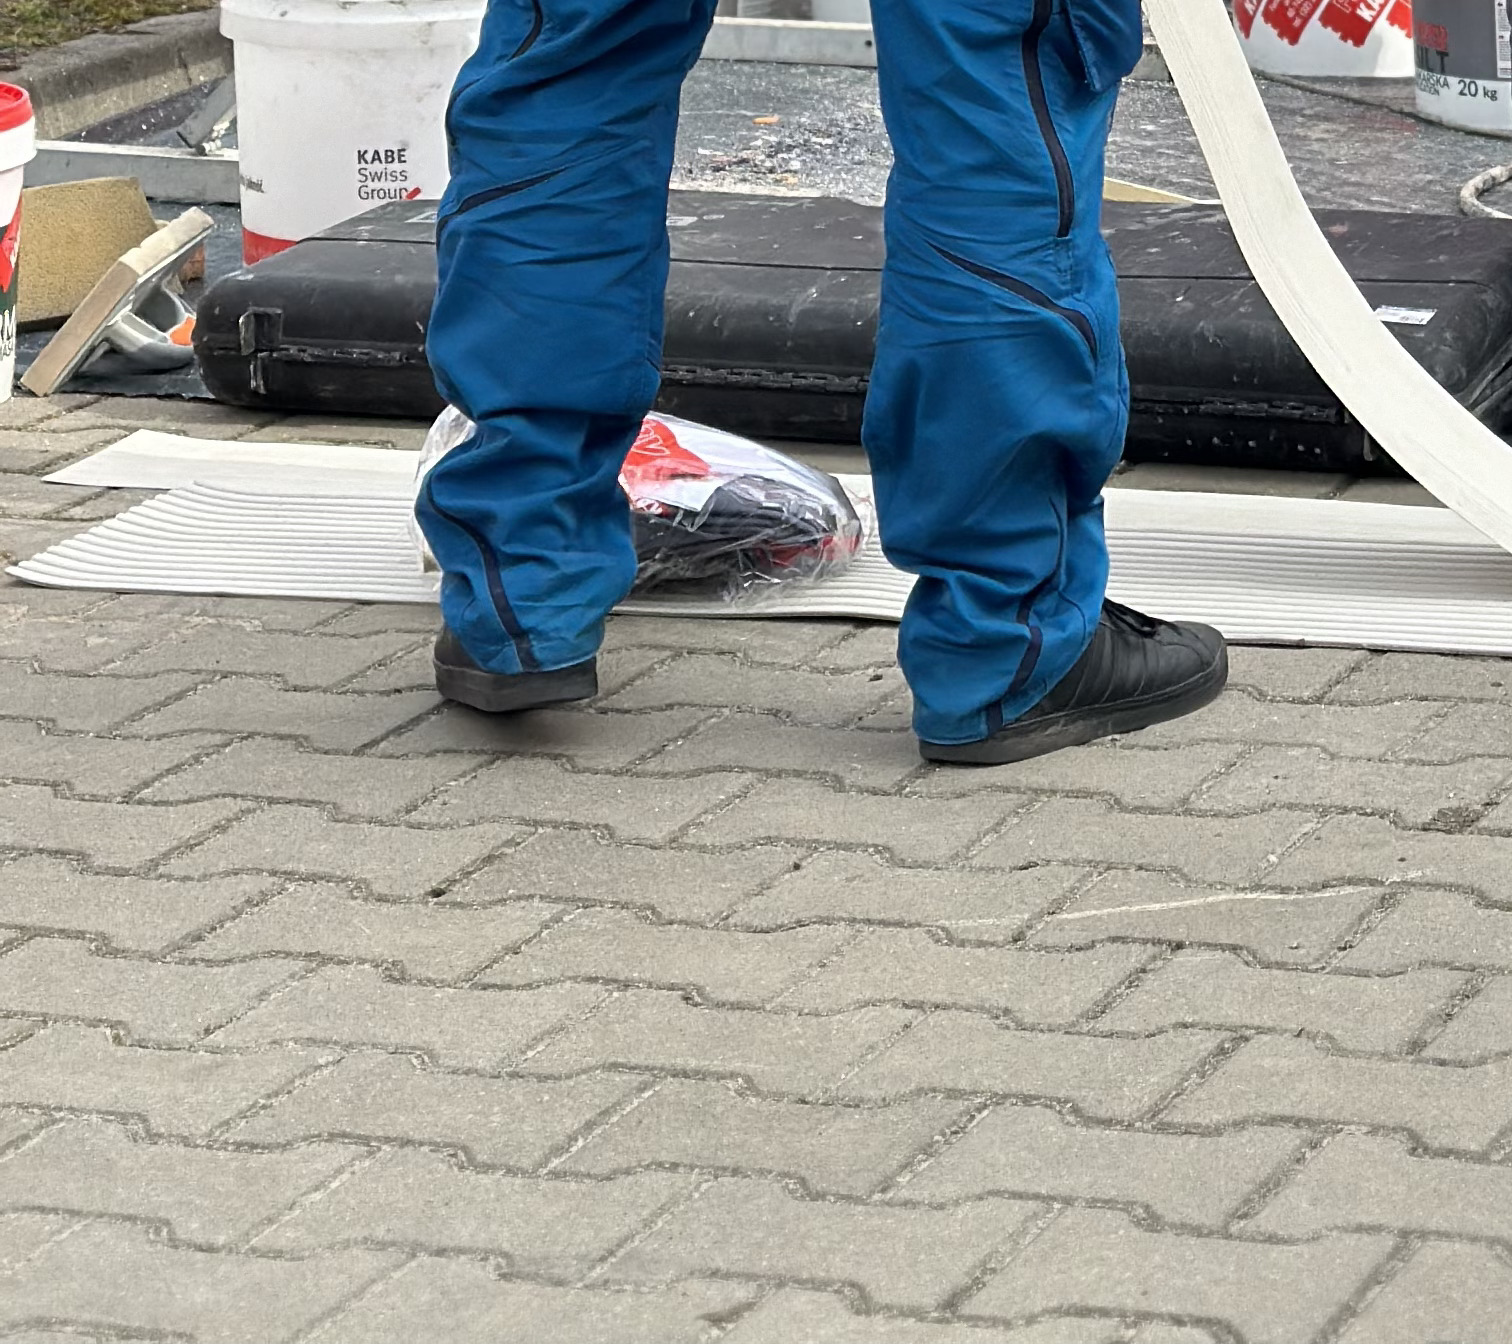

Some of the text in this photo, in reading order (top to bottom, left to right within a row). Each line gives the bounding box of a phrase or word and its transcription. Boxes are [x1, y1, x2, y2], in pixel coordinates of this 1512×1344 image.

[1457, 79, 1479, 98] 20
[1482, 85, 1498, 102] kg
[357, 148, 408, 165] KABE
[357, 166, 409, 183] Swiss
